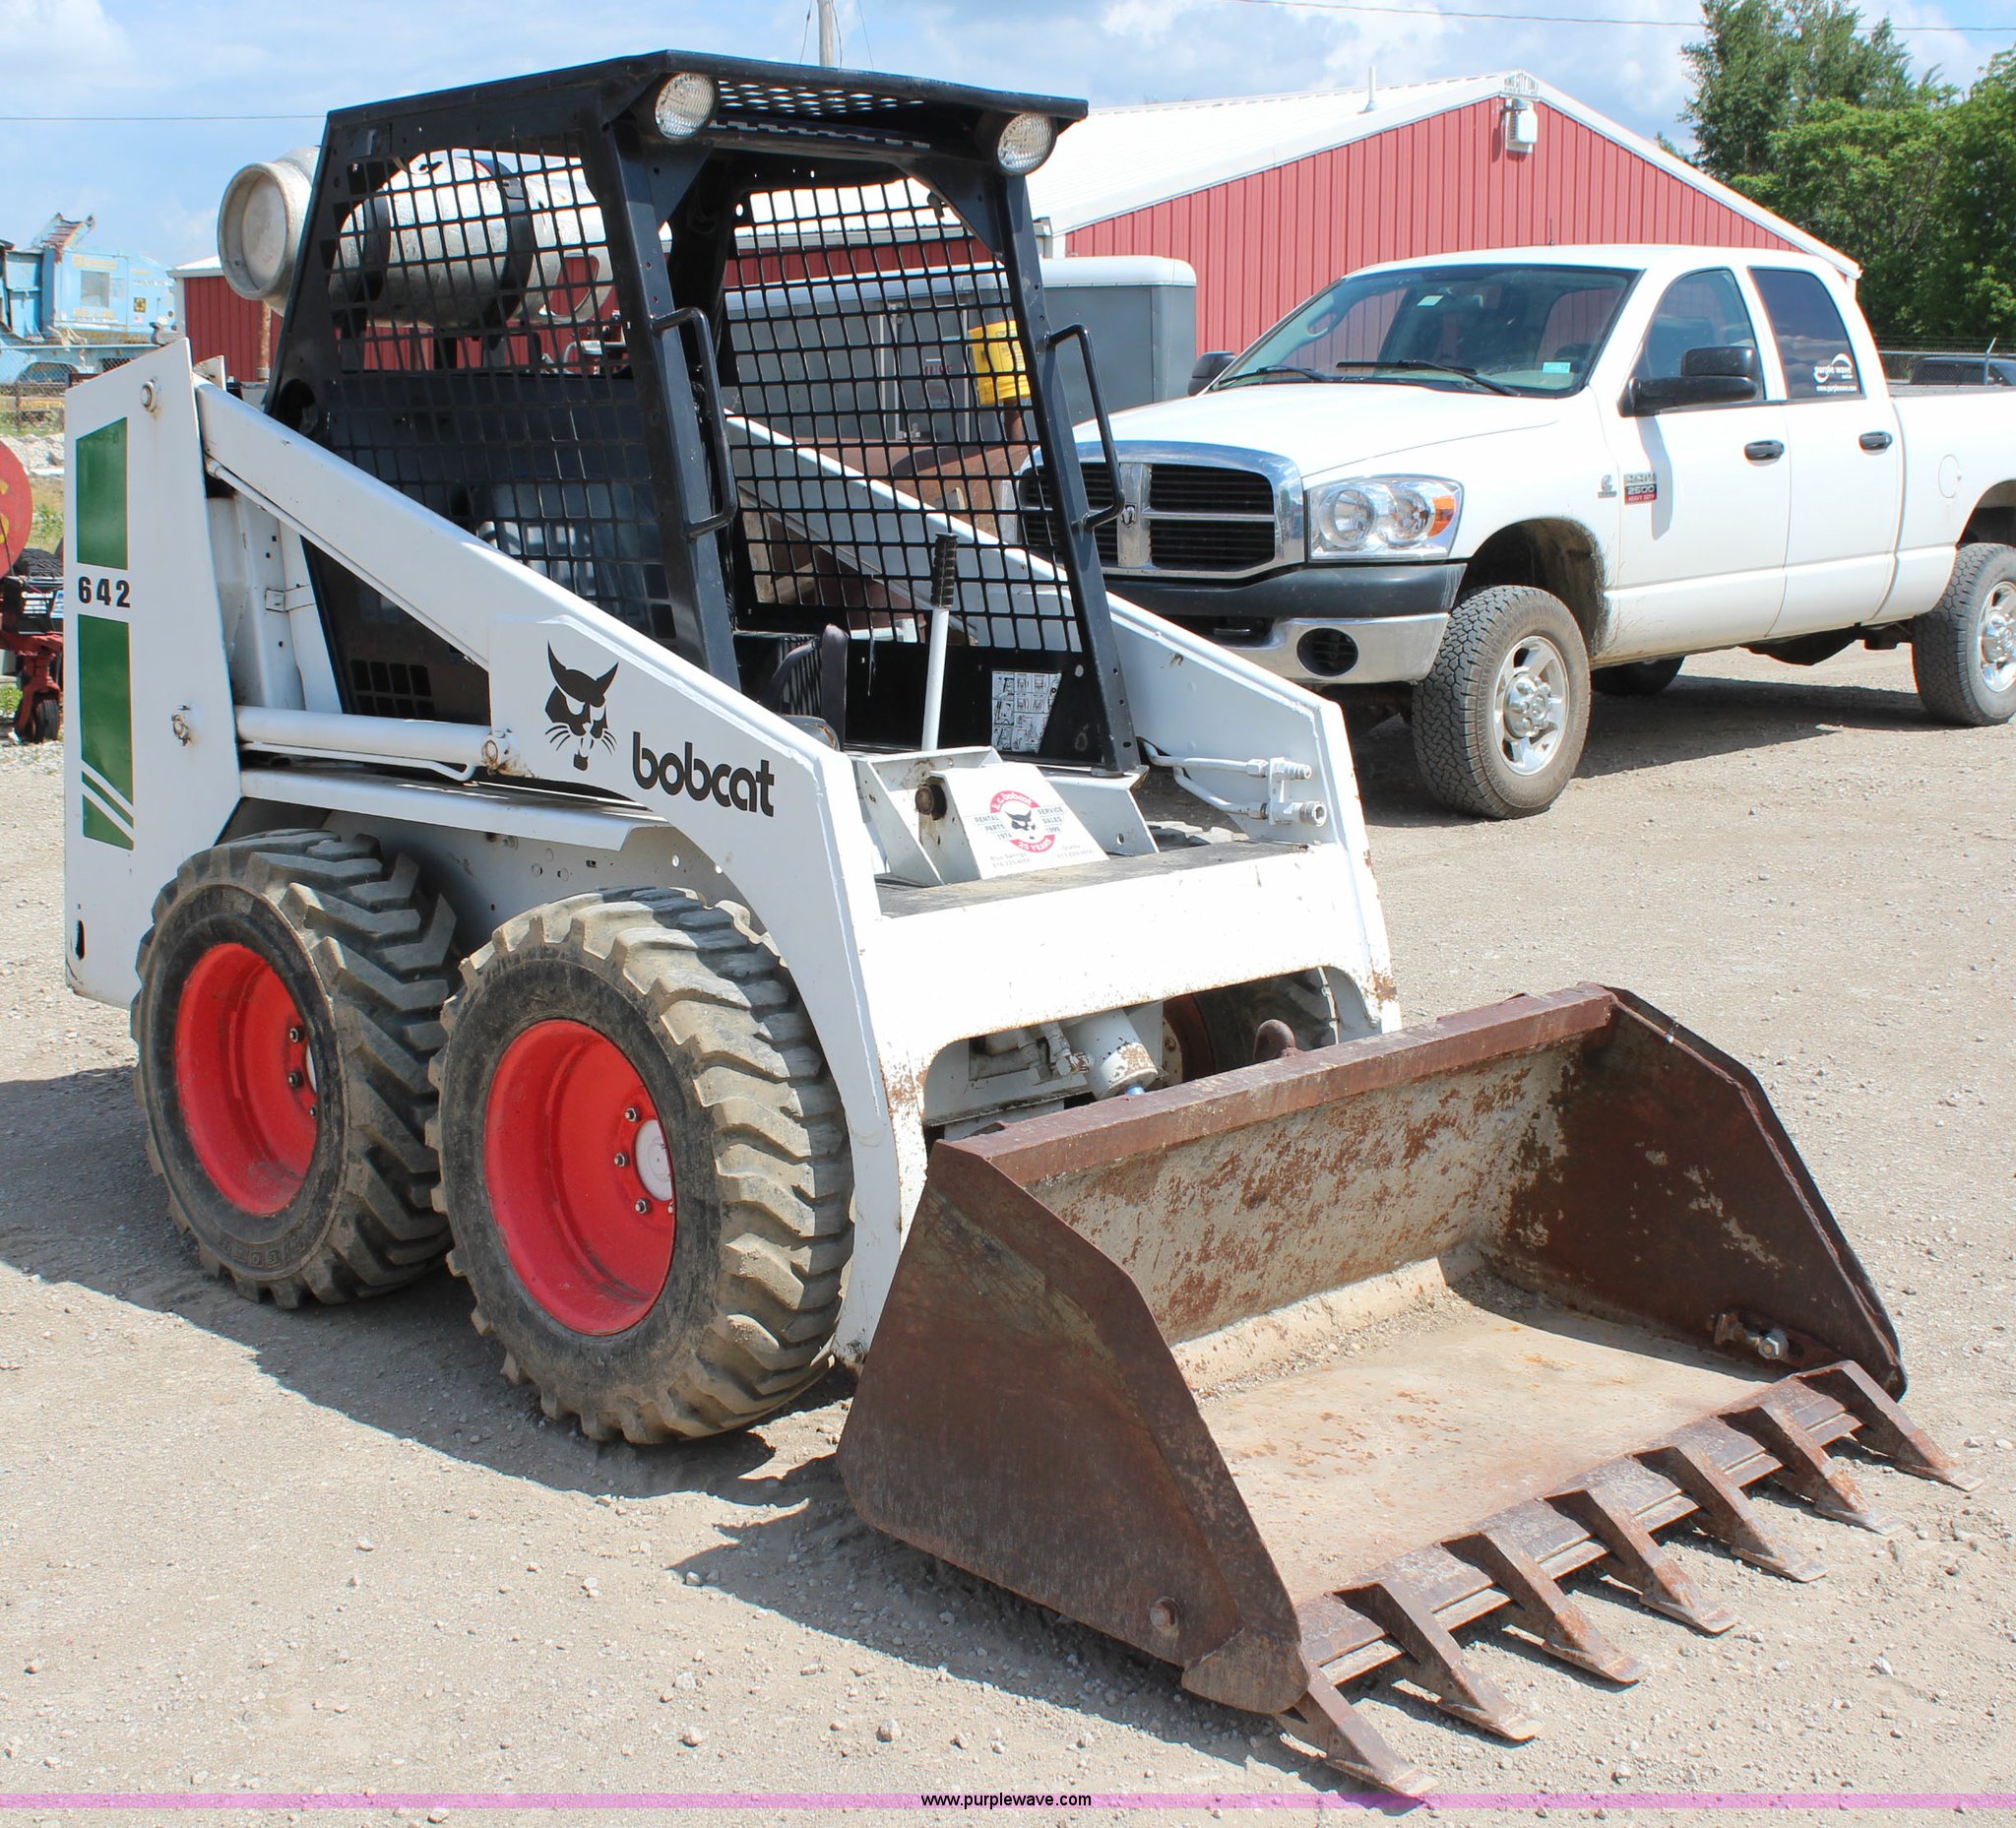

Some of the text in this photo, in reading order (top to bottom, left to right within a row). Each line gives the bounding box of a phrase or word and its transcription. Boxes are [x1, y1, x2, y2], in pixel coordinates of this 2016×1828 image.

[1627, 484, 1655, 495] 2500
[78, 576, 130, 608] 642
[633, 731, 775, 817] bobcat
[1038, 806, 1064, 815] SERVICE
